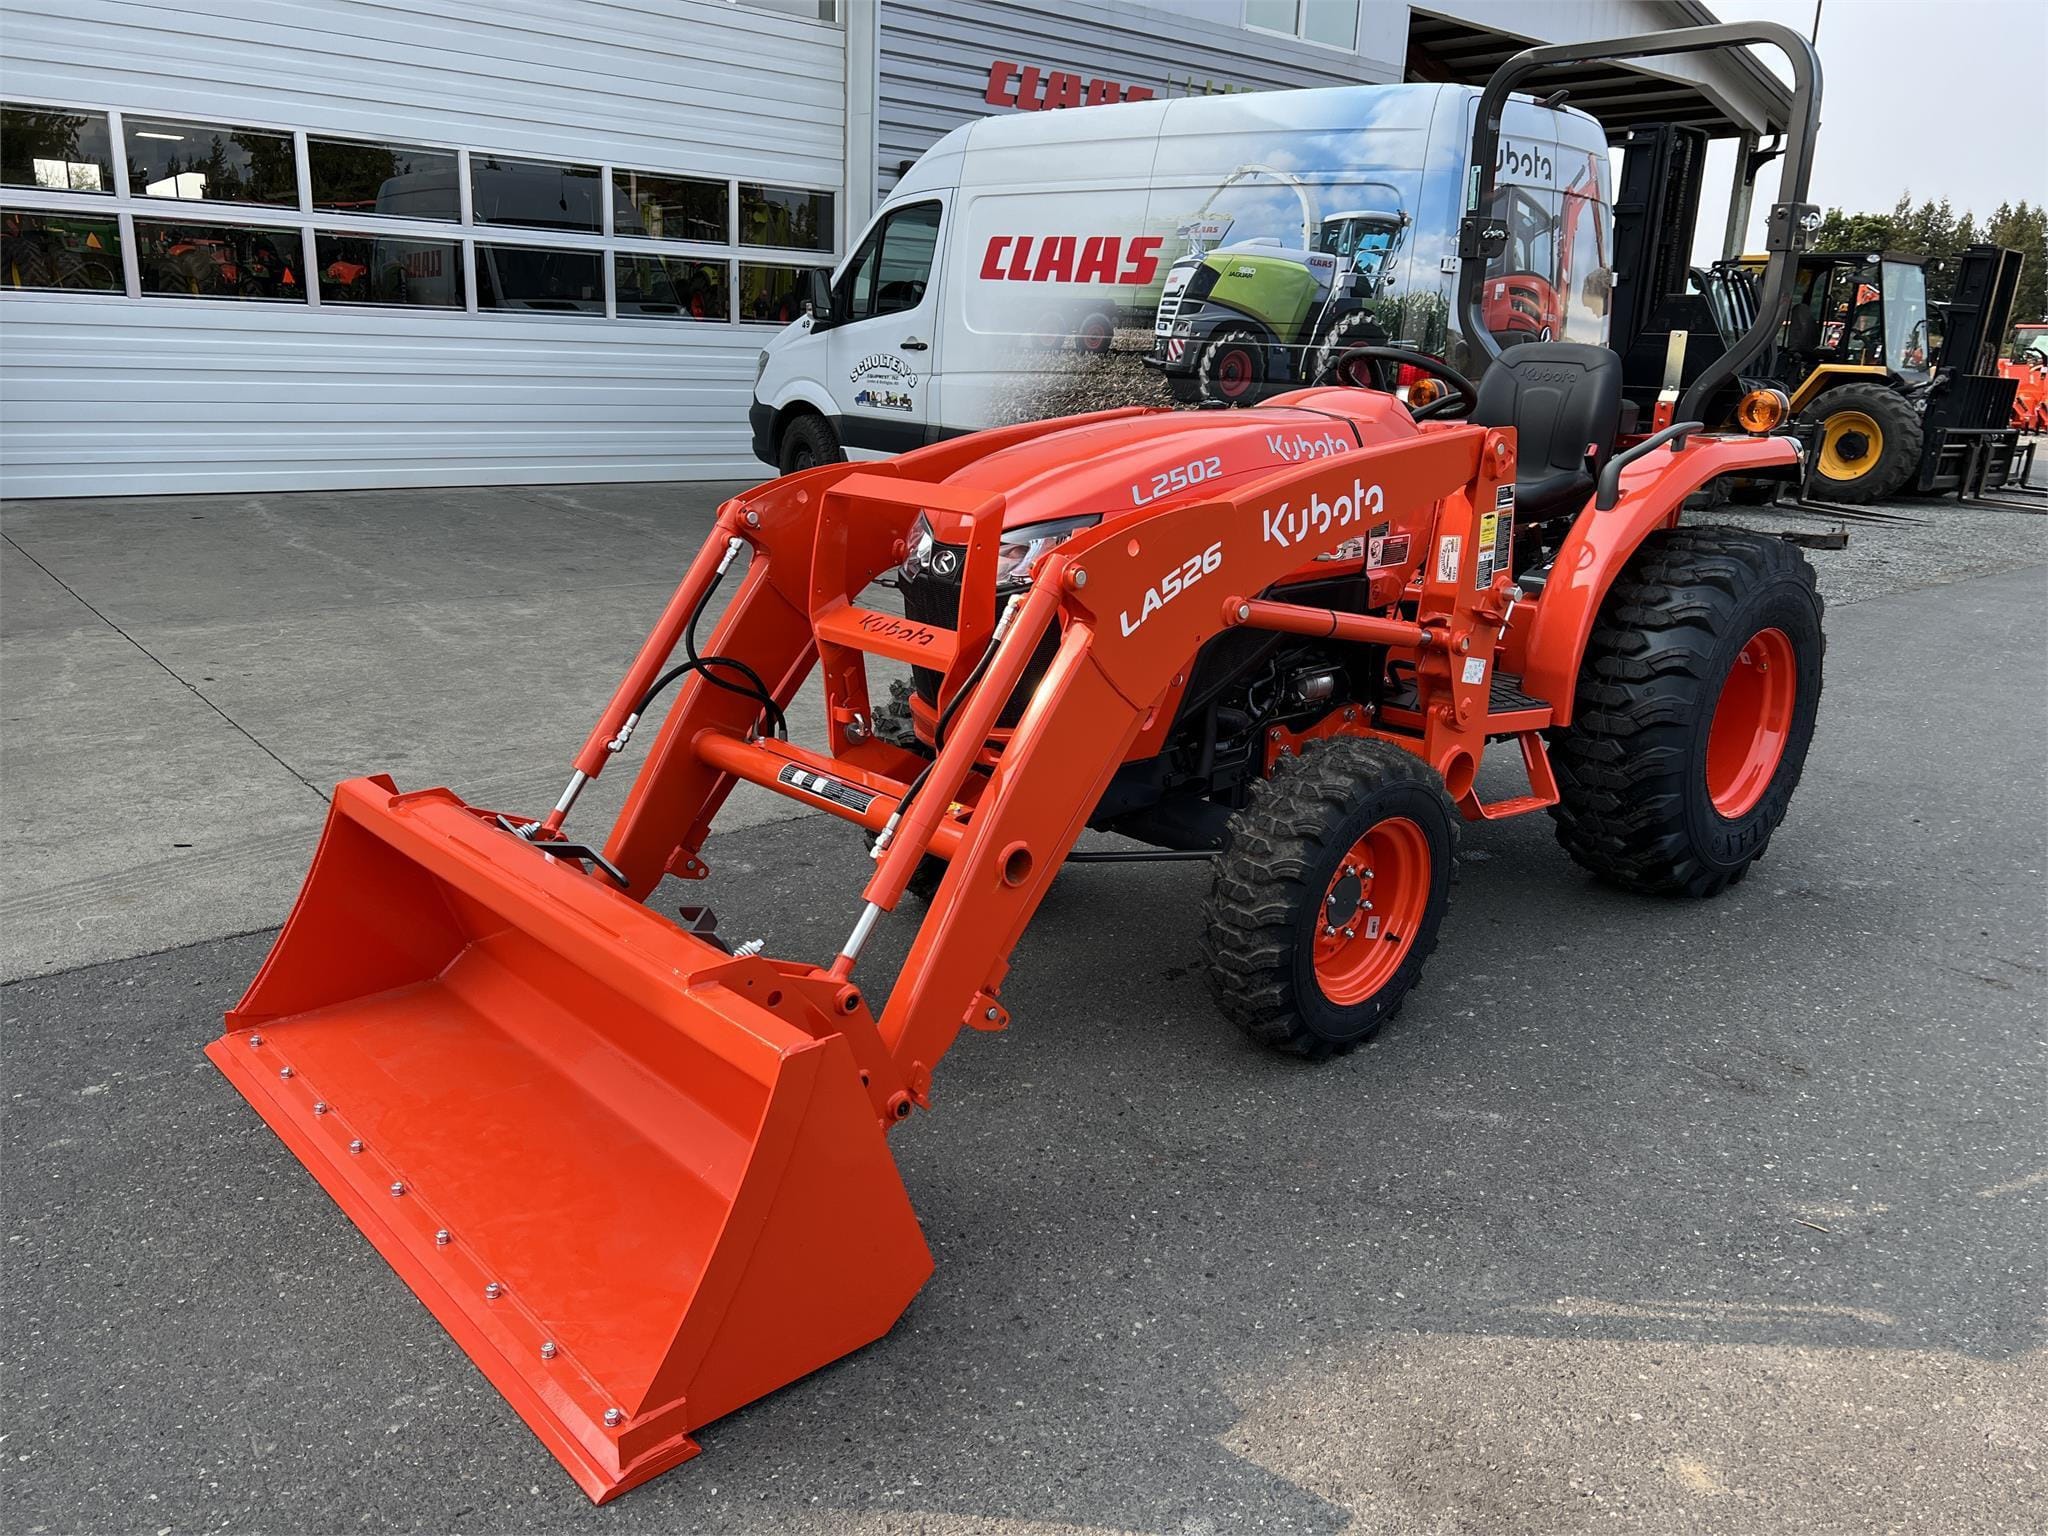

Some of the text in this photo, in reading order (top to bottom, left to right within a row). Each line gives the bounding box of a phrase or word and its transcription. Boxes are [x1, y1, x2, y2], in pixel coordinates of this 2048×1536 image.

[1496, 141, 1552, 181] ubota
[980, 236, 1164, 285] CLAAS
[1228, 271, 1254, 279] JAGUAR
[1309, 257, 1333, 269] CLAAS
[801, 320, 811, 329] 49
[849, 353, 919, 389] SCHOLTEN'S
[1519, 366, 1578, 383] Kubota
[1266, 432, 1350, 462] Kubota
[1131, 456, 1223, 507] L2502
[1263, 478, 1384, 548] Kubota
[1119, 541, 1223, 638] LA526
[858, 614, 935, 646] Kubota
